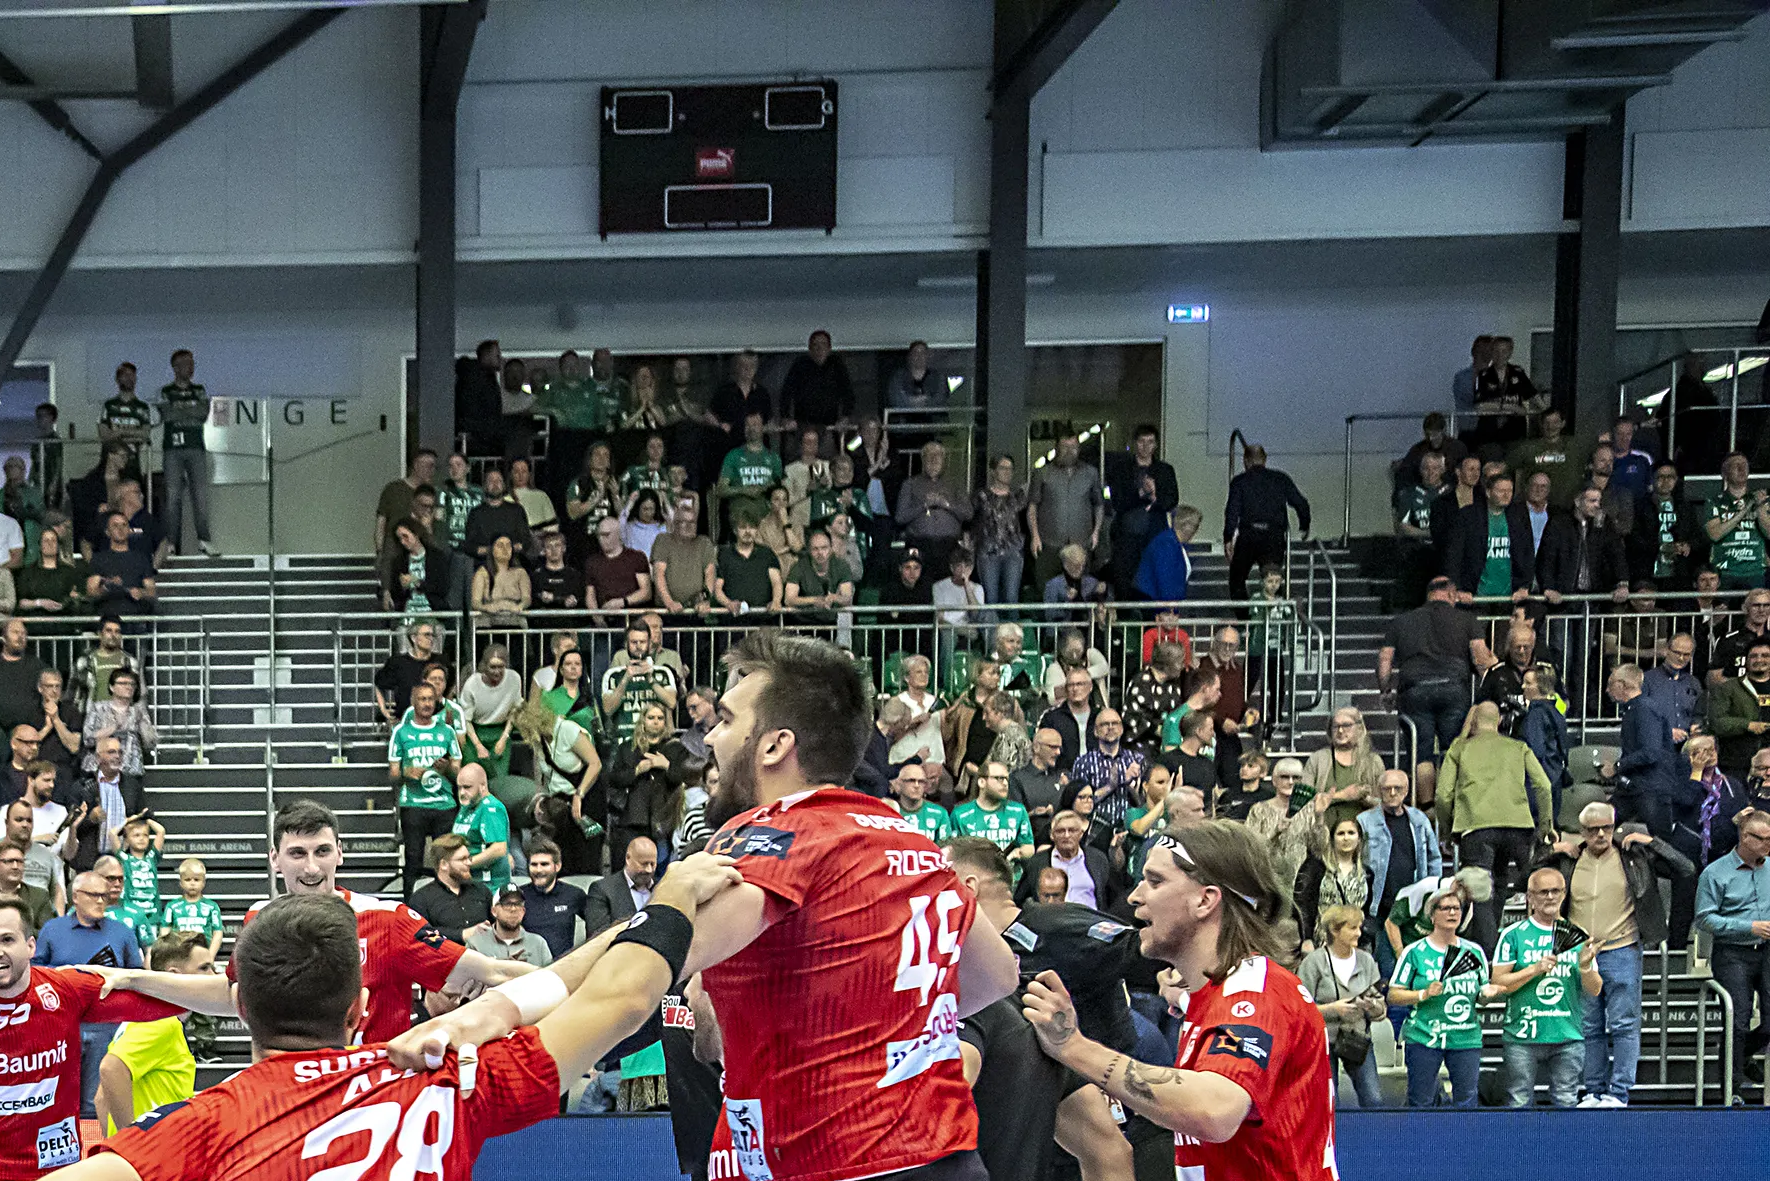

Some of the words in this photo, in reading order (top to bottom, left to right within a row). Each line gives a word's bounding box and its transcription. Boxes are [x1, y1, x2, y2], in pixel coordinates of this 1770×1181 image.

[1486, 548, 1511, 559] ANK
[1523, 949, 1578, 964] SKRN
[1443, 979, 1477, 994] ANK
[1653, 1011, 1686, 1021] BNK
[1690, 1011, 1722, 1021] AEN
[219, 1021, 251, 1030] AREN
[1516, 1019, 1537, 1039] 21
[1426, 1032, 1447, 1050] 21
[294, 1049, 388, 1083] SUP
[39, 1130, 77, 1152] DELTA
[39, 1145, 80, 1160] GLASS
